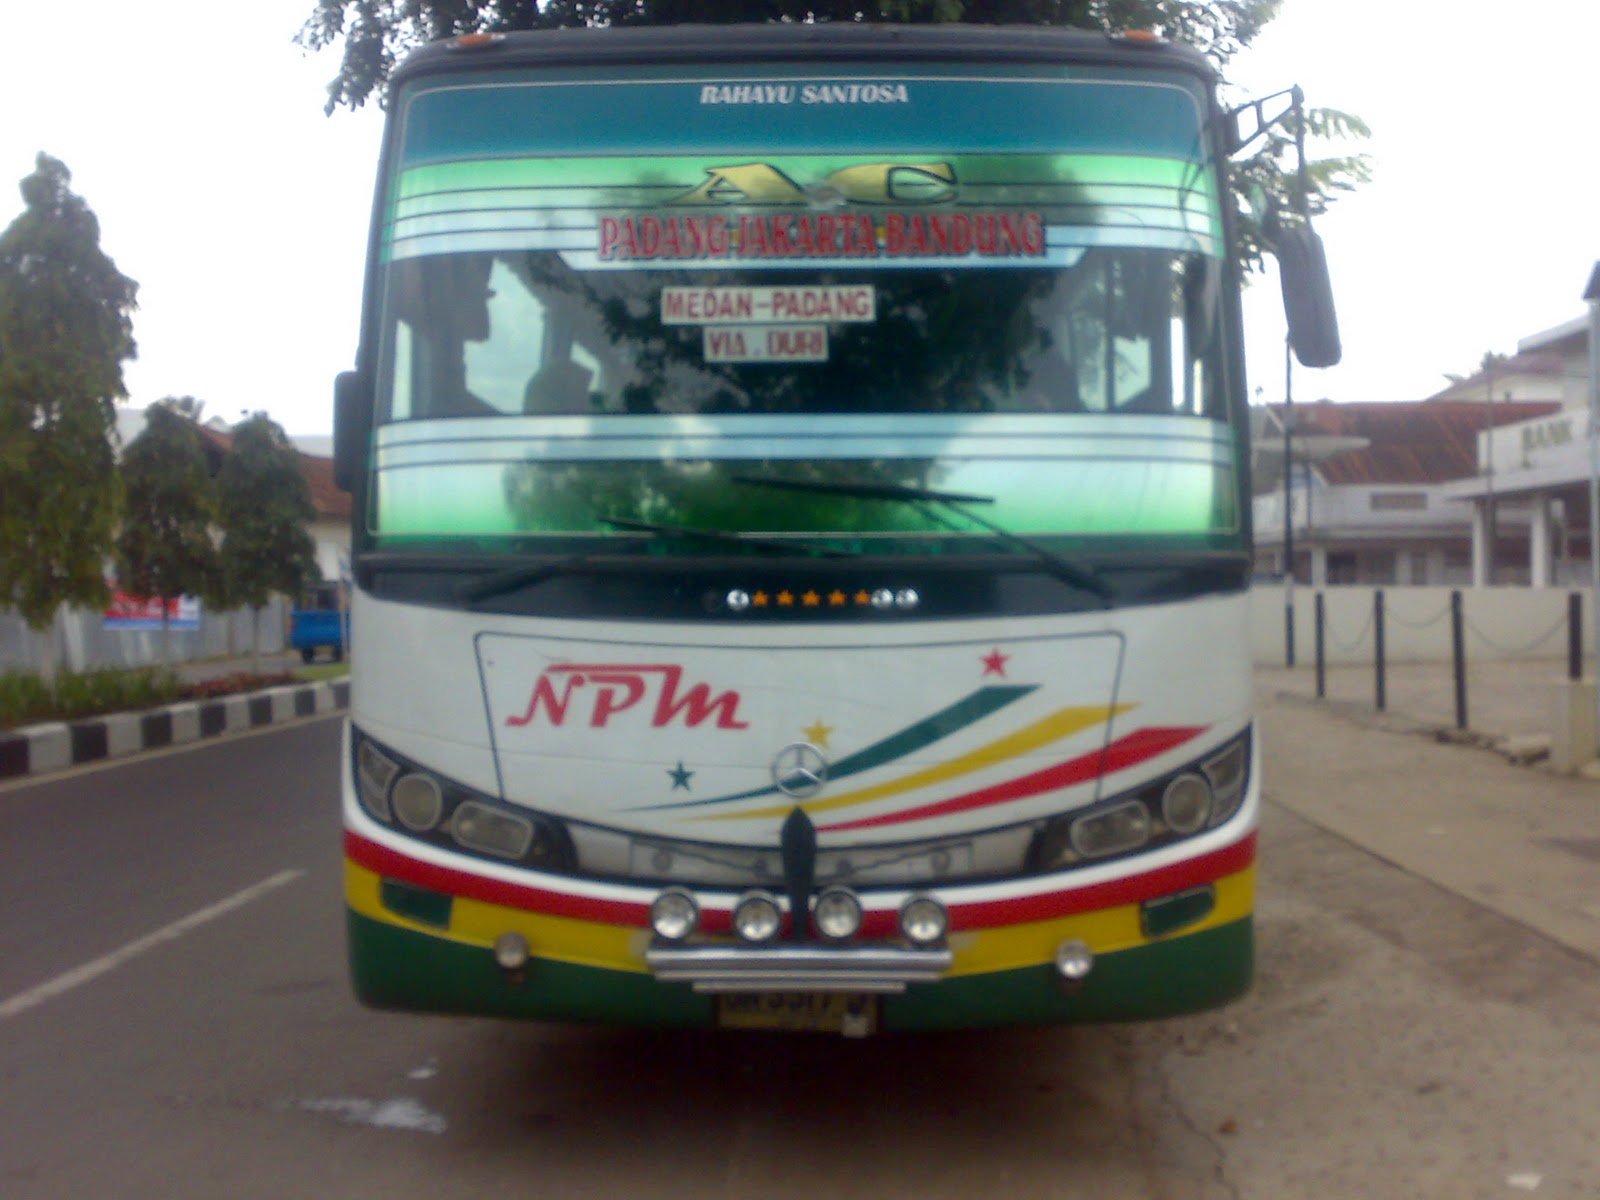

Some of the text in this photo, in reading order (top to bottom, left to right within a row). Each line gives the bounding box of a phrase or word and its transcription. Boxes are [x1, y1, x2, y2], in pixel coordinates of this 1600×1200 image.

[700, 83, 910, 104] RAHAYU SANTOSA
[599, 212, 1045, 259] PADANG JAKARTA BANDUNG
